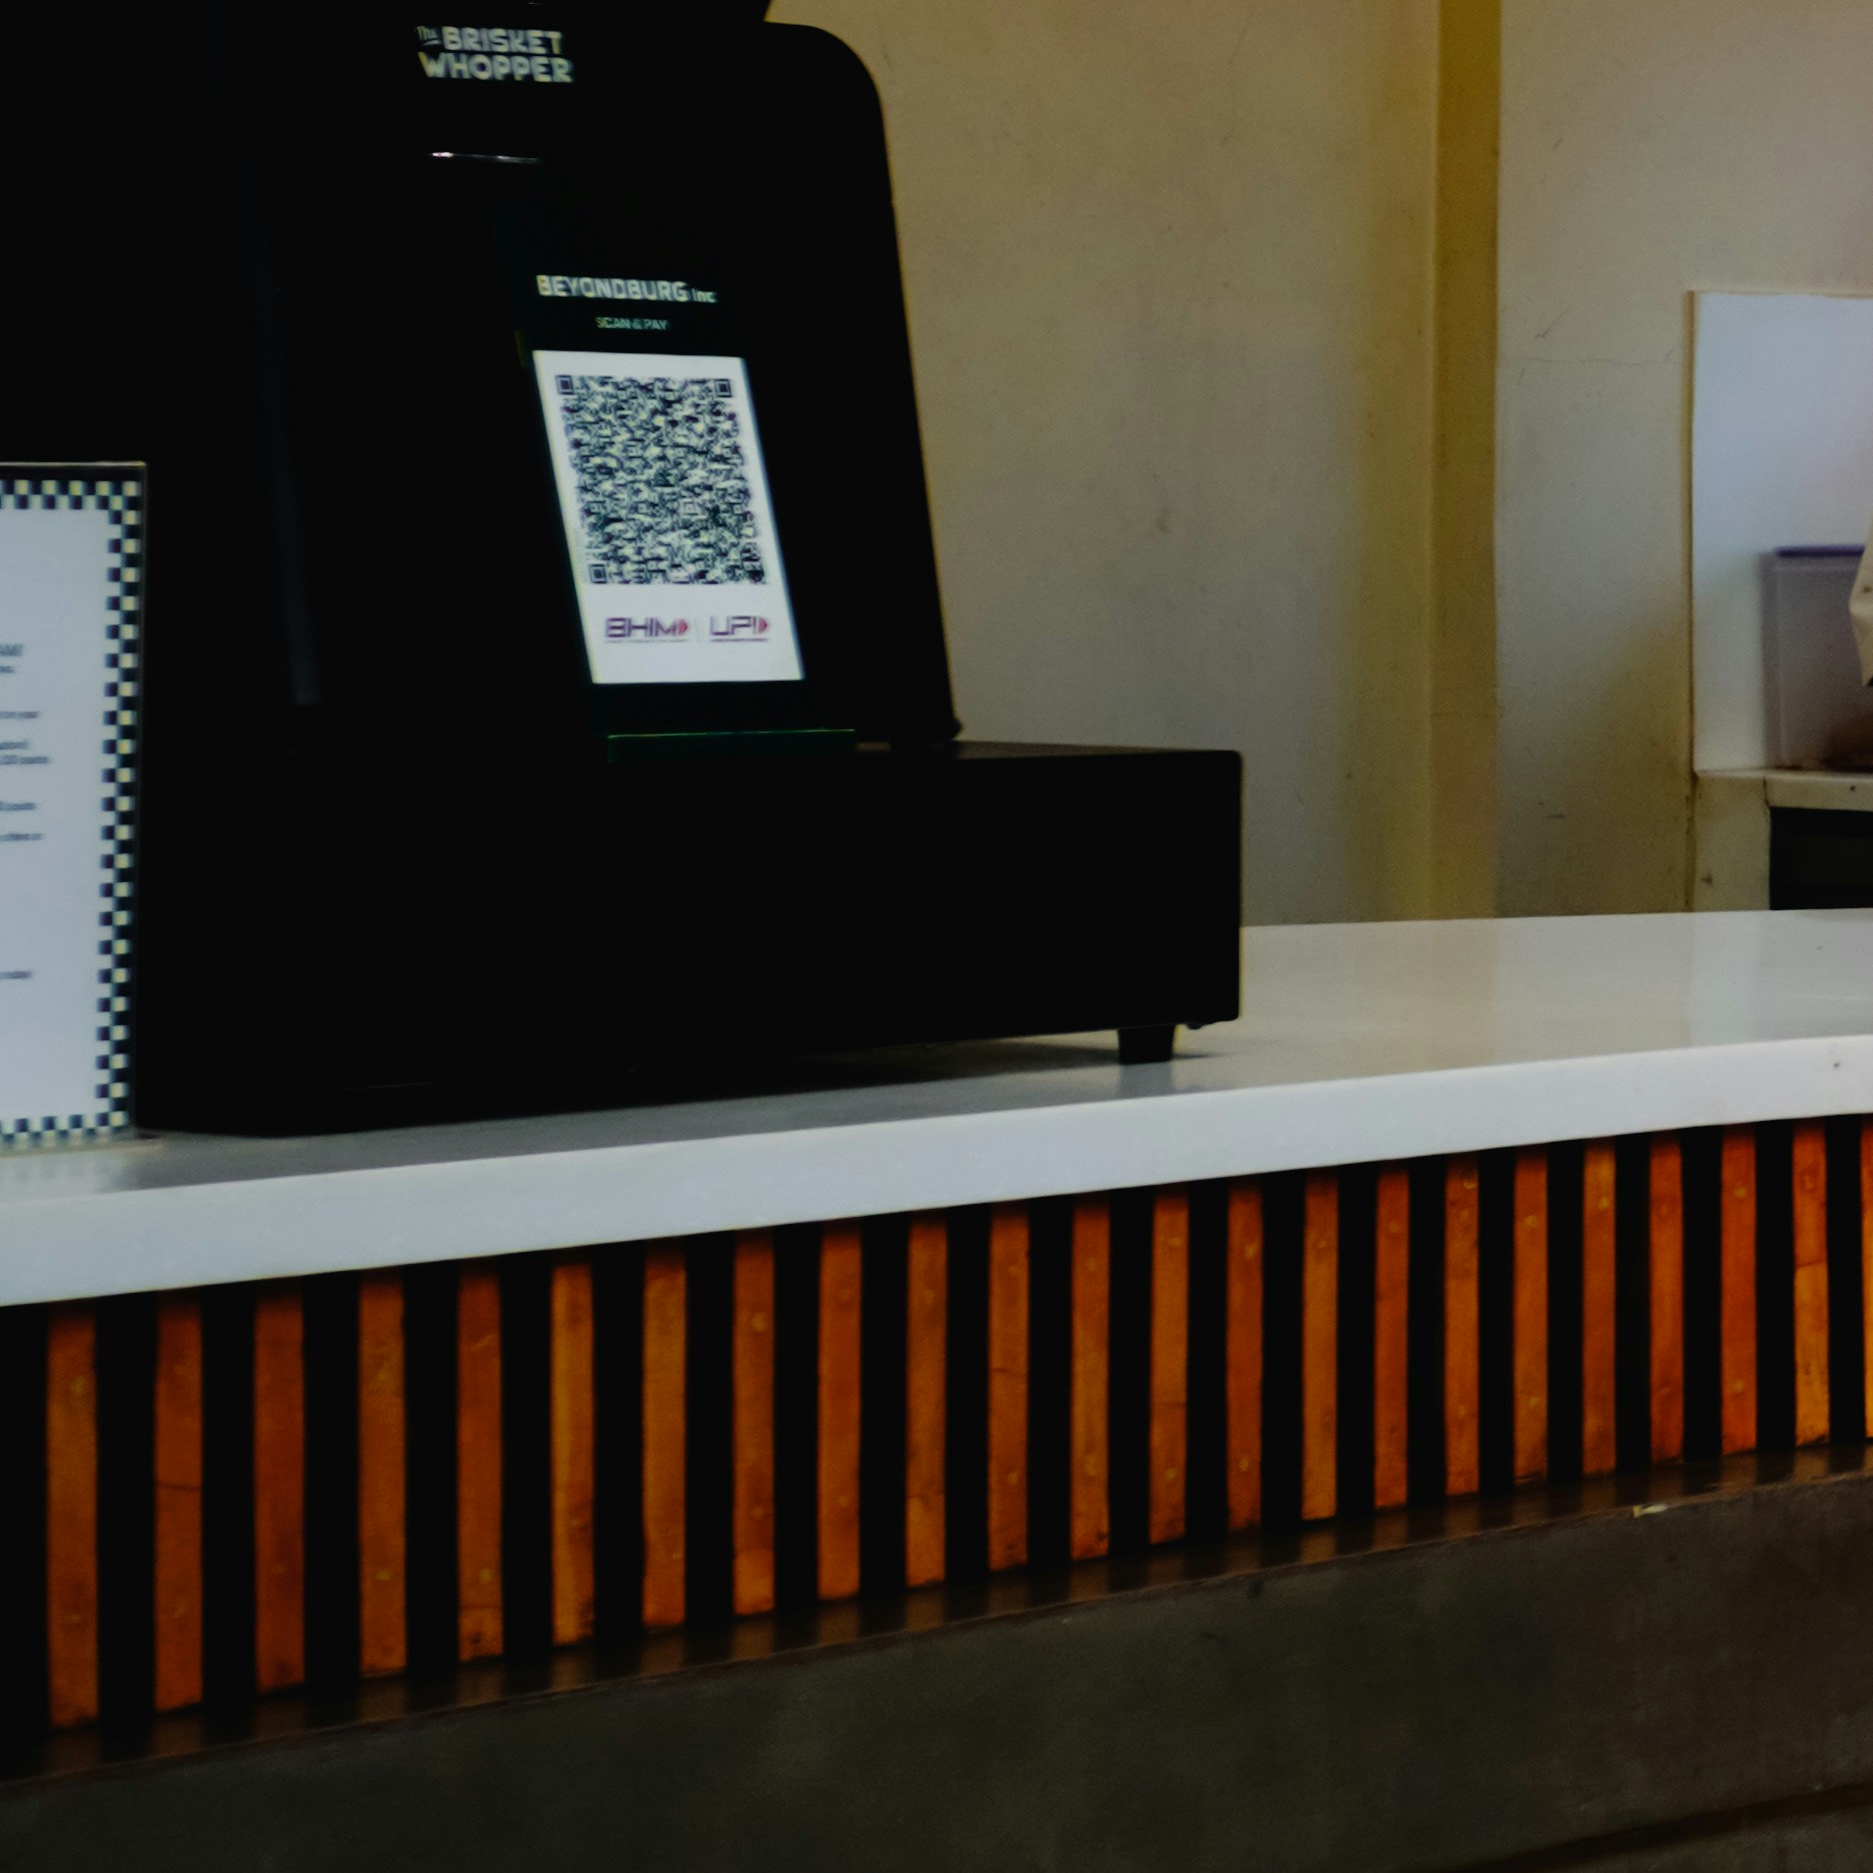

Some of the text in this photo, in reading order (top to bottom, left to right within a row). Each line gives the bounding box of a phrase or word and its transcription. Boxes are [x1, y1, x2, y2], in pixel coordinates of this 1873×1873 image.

[416, 25, 564, 55] The BRISKET
[417, 51, 575, 83] WHOPPER
[535, 274, 690, 303] BEYONDBURG
[595, 316, 670, 331] SCAN & PAY
[605, 616, 680, 639] BHIM
